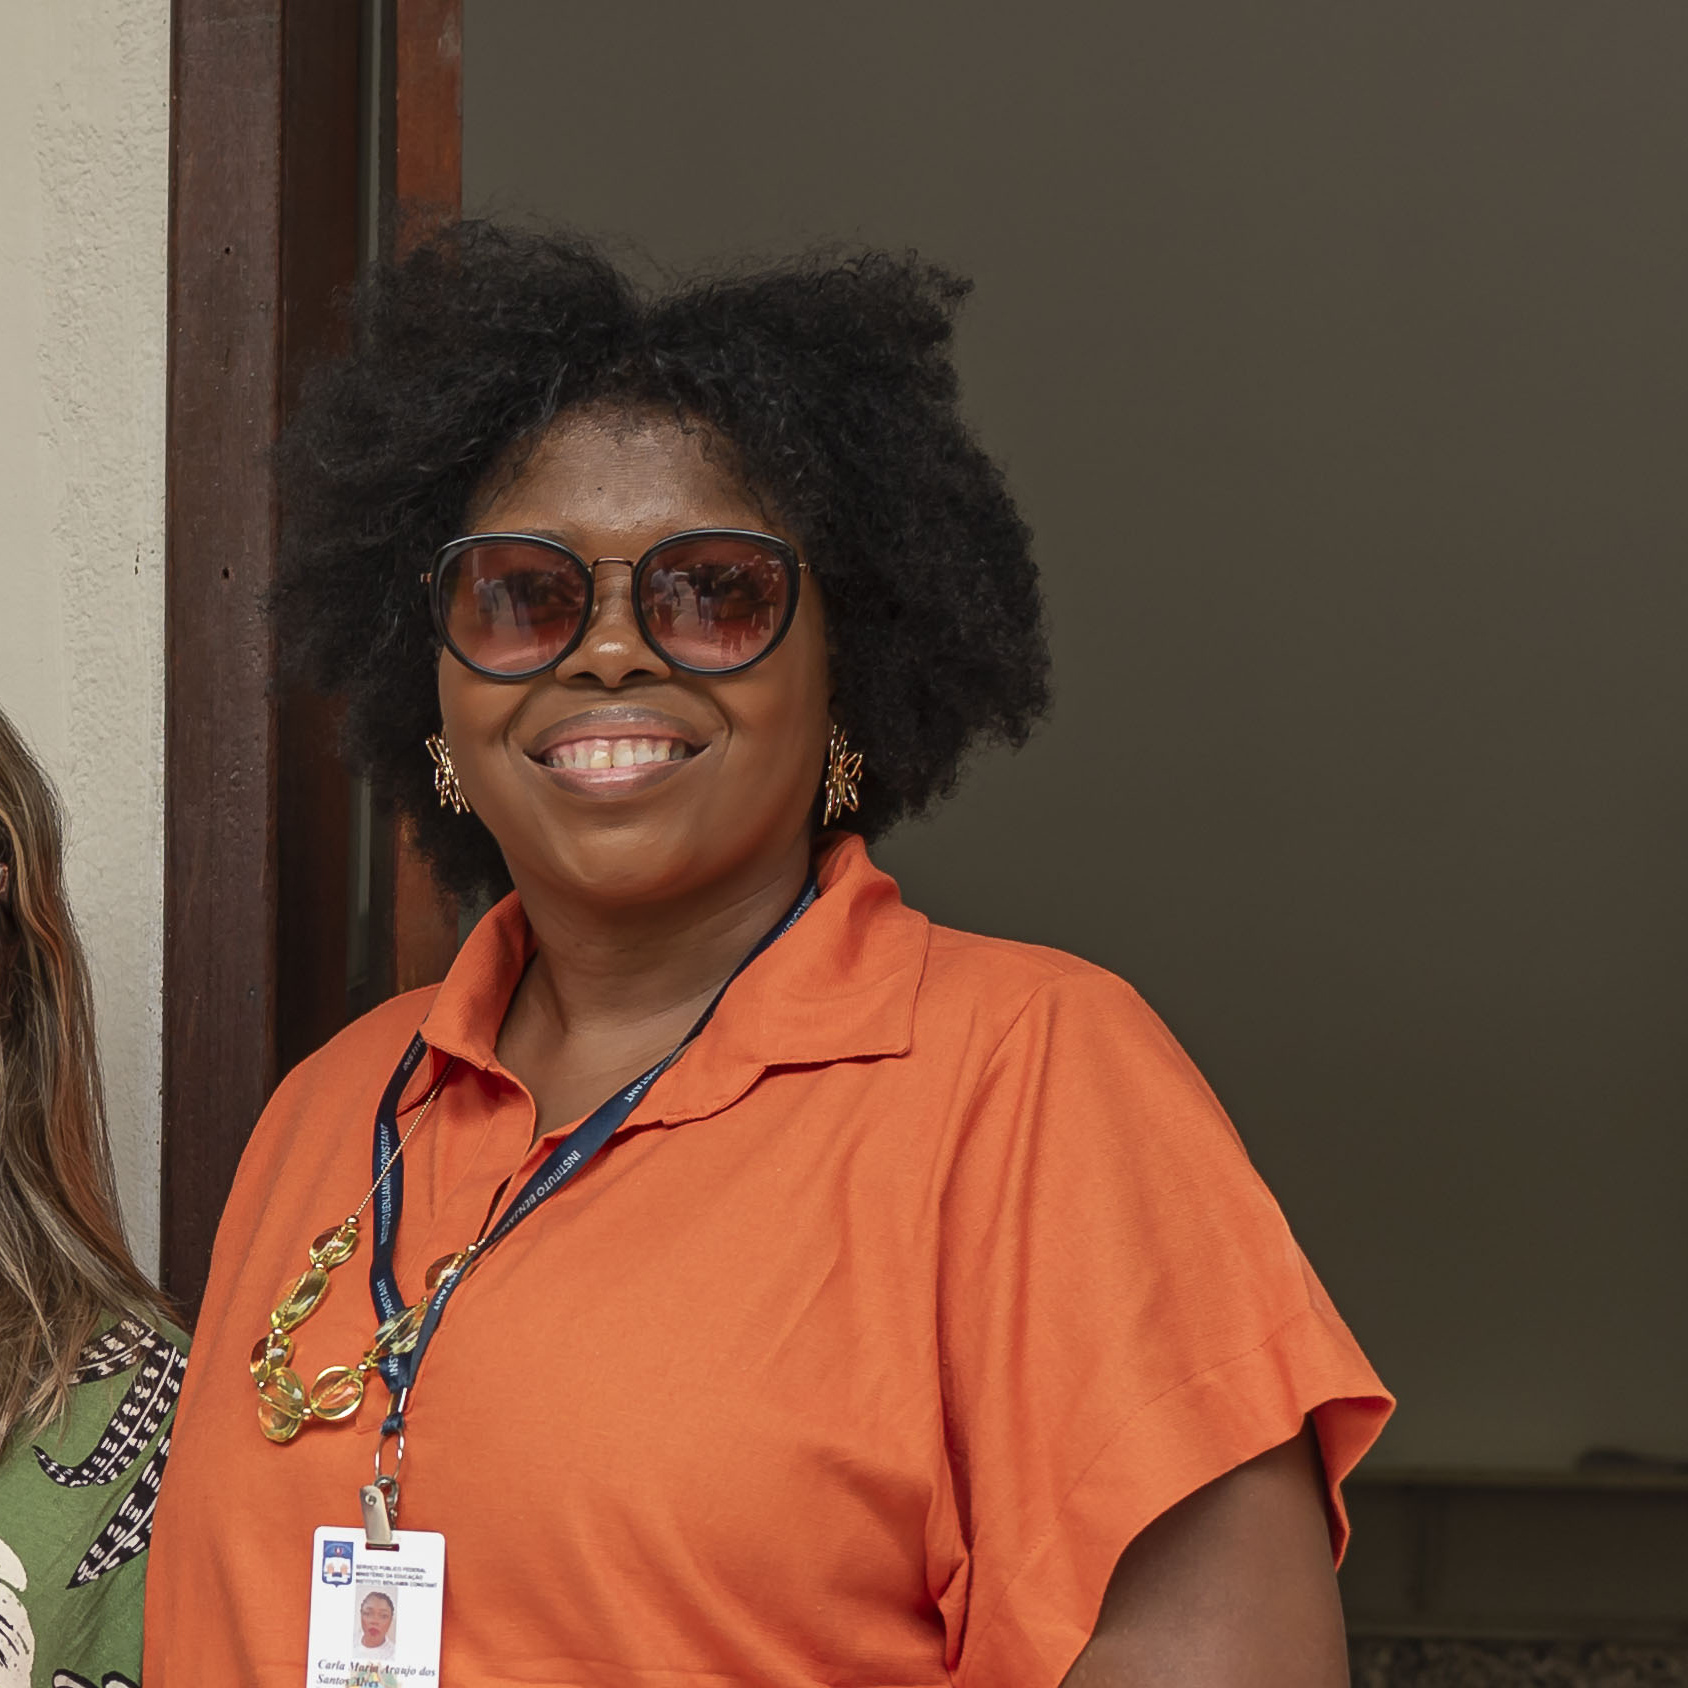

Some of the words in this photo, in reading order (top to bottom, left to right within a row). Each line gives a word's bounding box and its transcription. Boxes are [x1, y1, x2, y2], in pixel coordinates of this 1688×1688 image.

[536, 1149, 583, 1198] INSTITUTO
[317, 1659, 345, 1671] Carla
[419, 1666, 436, 1677] dos
[316, 1674, 350, 1686] Santos
